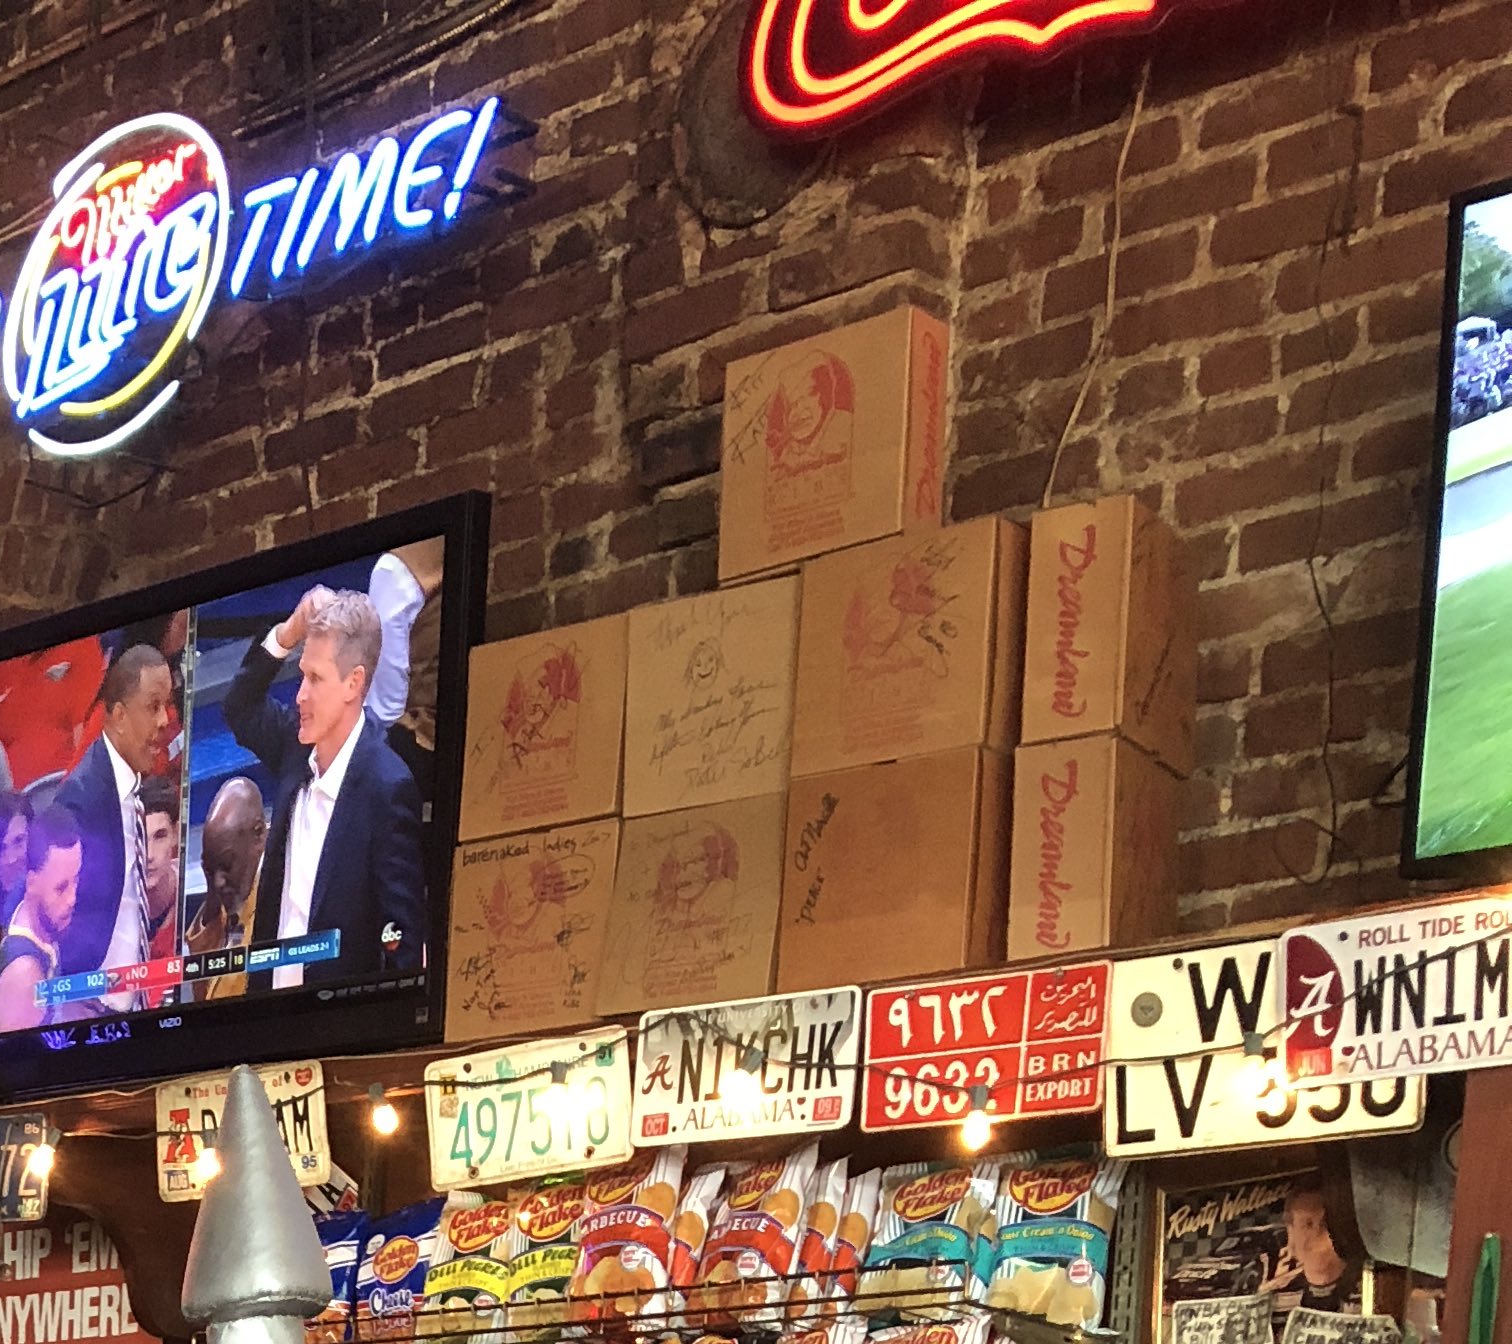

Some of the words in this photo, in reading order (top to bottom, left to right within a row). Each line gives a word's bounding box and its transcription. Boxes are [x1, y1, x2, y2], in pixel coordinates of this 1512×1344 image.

[230, 97, 498, 297] TIME!
[1052, 524, 1096, 718] Dreamland
[1036, 759, 1078, 950] Dreamland
[381, 928, 402, 943] abc
[1358, 923, 1411, 949] ROLL
[1418, 914, 1465, 940] TIDE
[86, 972, 104, 988] 102
[167, 959, 181, 974] 83
[1187, 951, 1272, 1044] W
[884, 1056, 1000, 1120] 9632
[1025, 1077, 1093, 1103] EXPORT
[1115, 1054, 1213, 1145] LV
[300, 1155, 318, 1170] 95
[1023, 1177, 1092, 1202] Flake
[1166, 1200, 1218, 1241] Rusty
[1219, 1183, 1292, 1224] Wallace
